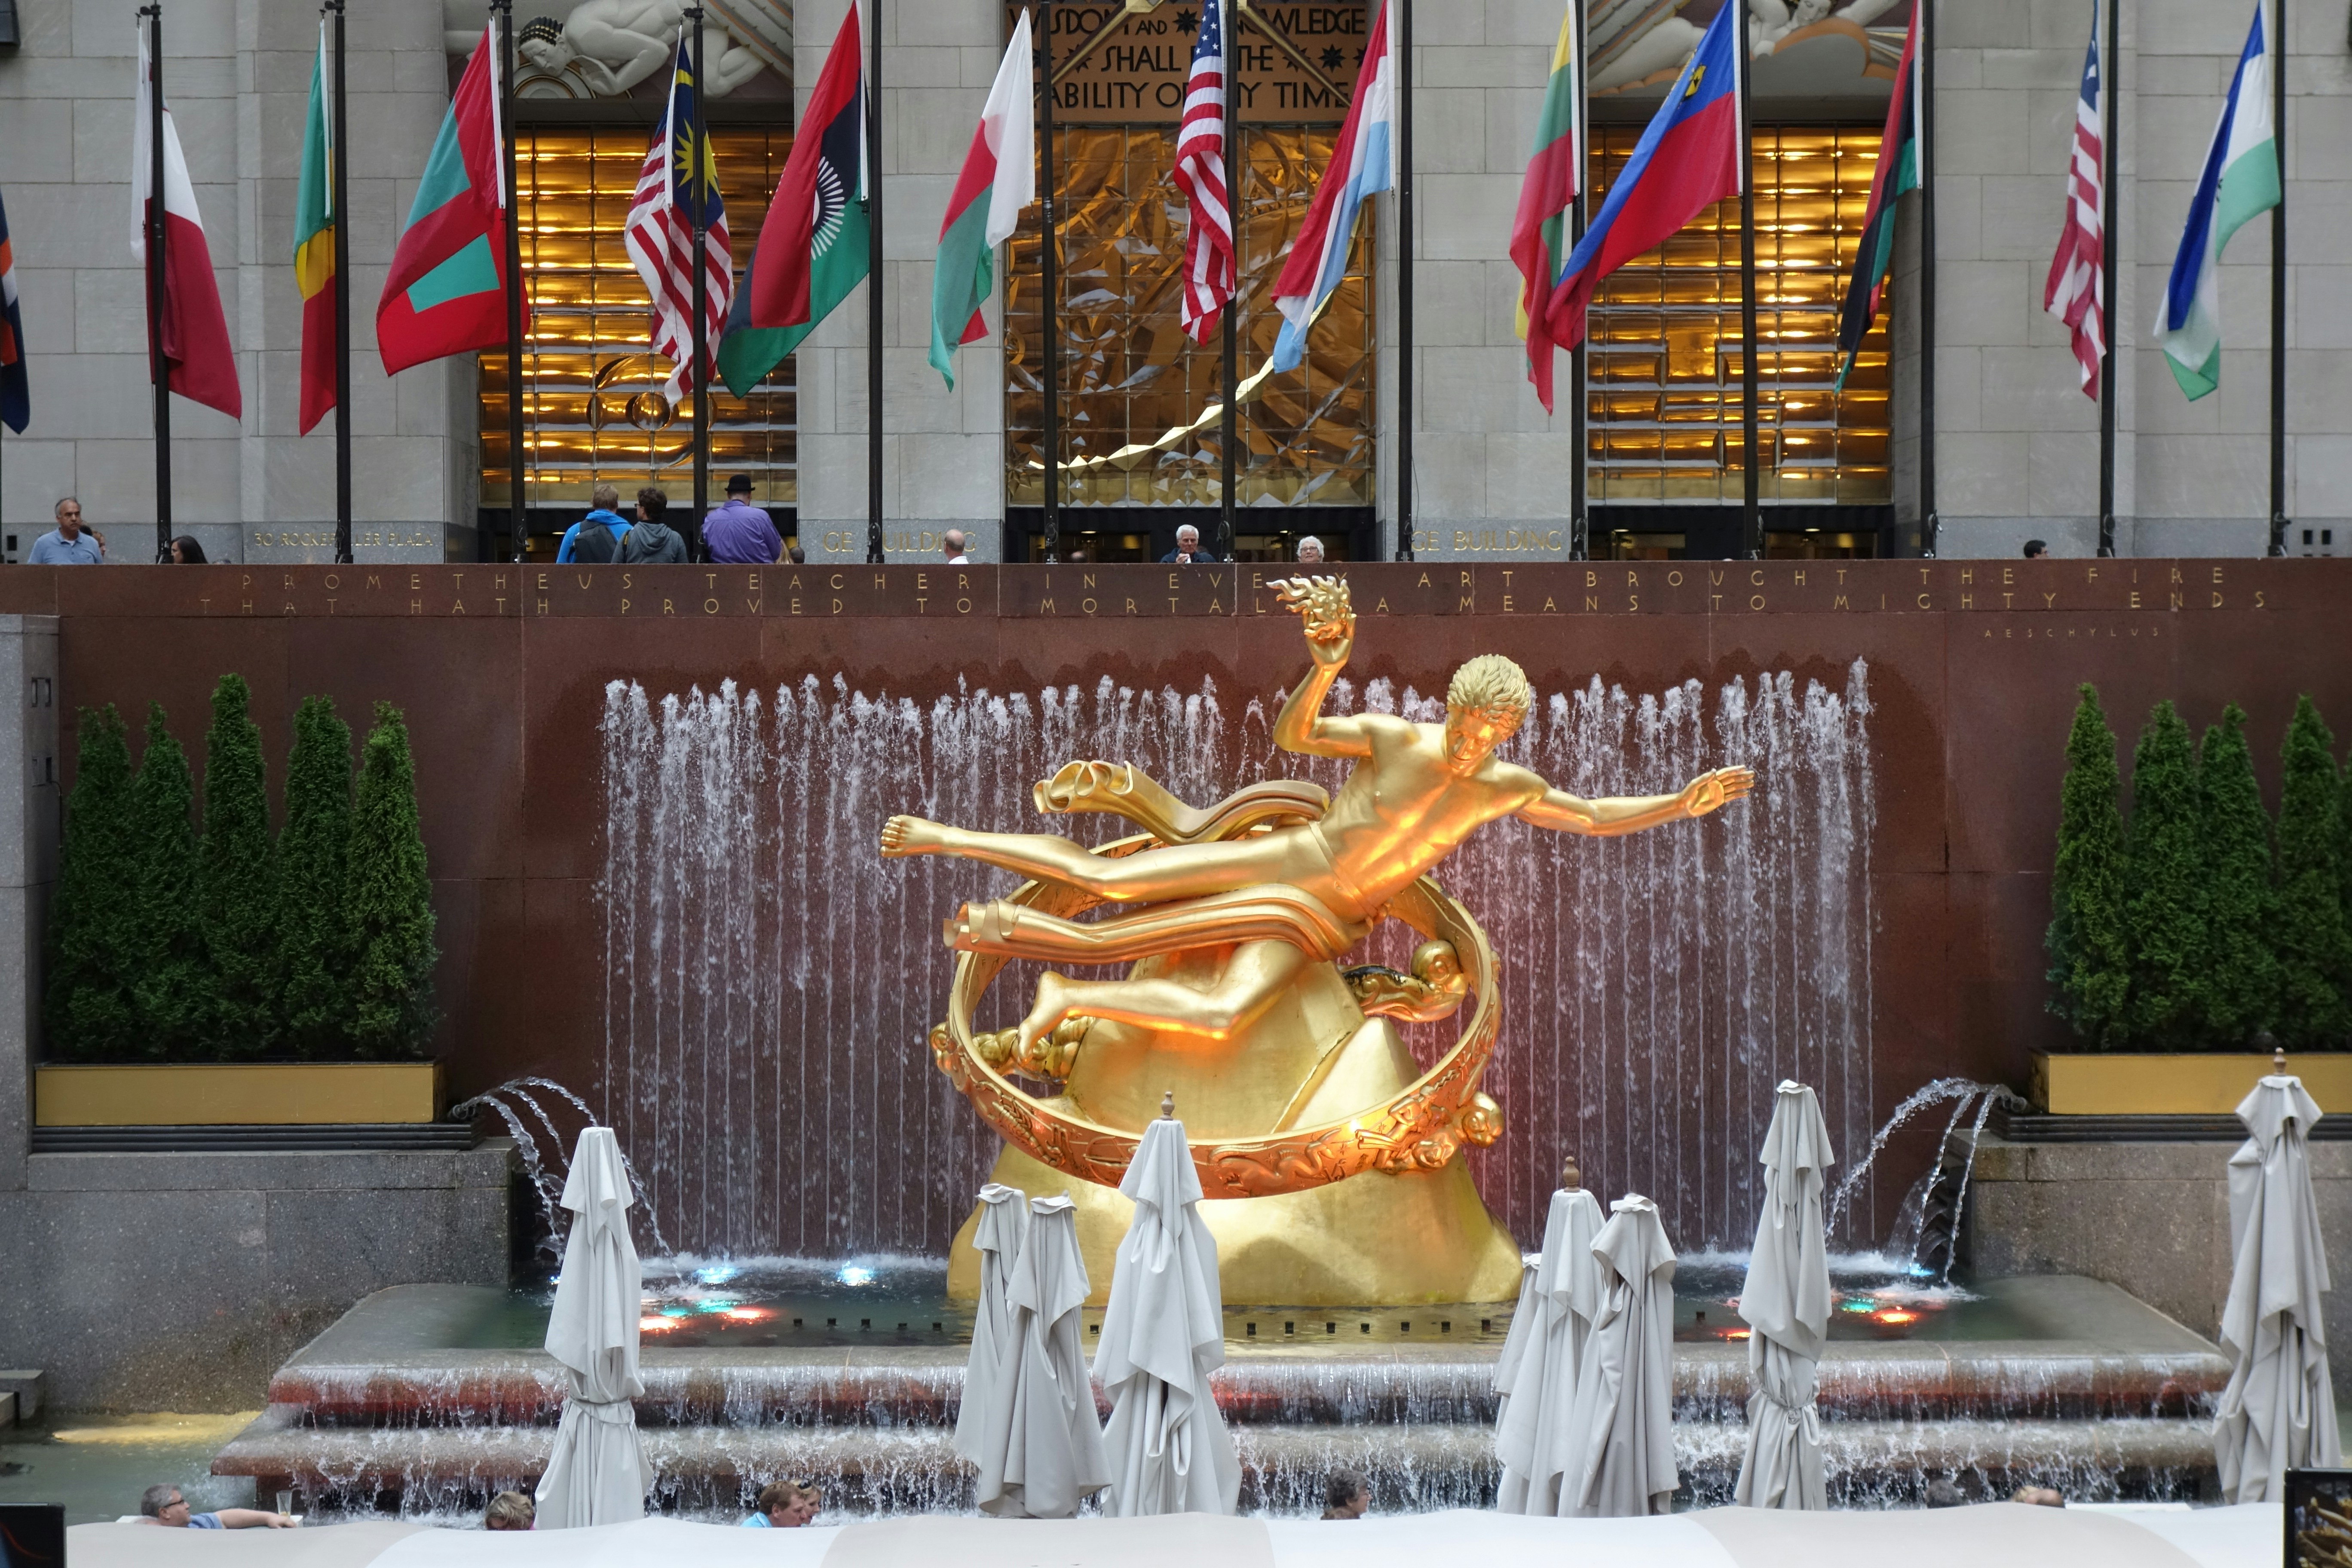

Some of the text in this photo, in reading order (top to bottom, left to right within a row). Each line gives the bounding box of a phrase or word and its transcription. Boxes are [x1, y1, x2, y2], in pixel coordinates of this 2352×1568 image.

[1135, 20, 1167, 35] AND
[1101, 46, 1181, 72] SHALL
[1237, 45, 1273, 71] THE
[254, 533, 274, 546] 30
[389, 533, 433, 546] PLAZA
[823, 531, 976, 552] GE UILDIG
[1412, 530, 1562, 551] GE BUILDING
[242, 573, 632, 590] PROMETHEUS
[705, 573, 970, 590] TEACHER
[1046, 573, 1096, 589] IN
[1418, 570, 1513, 588] ART
[1586, 569, 1847, 588] BROUGHT
[1919, 568, 2015, 585] THE
[2088, 567, 2224, 584] FIRE
[200, 598, 338, 614] THAT
[410, 597, 549, 614] HATH
[621, 597, 844, 614] PROVED
[916, 597, 972, 614] TO
[1376, 596, 1390, 612] A
[1459, 595, 1638, 612] MEANS
[1712, 594, 1766, 611] TO
[1833, 593, 2057, 610] MIGHTY
[2130, 590, 2265, 609] ENDS
[1984, 628, 2159, 638] AESCHYLUS
